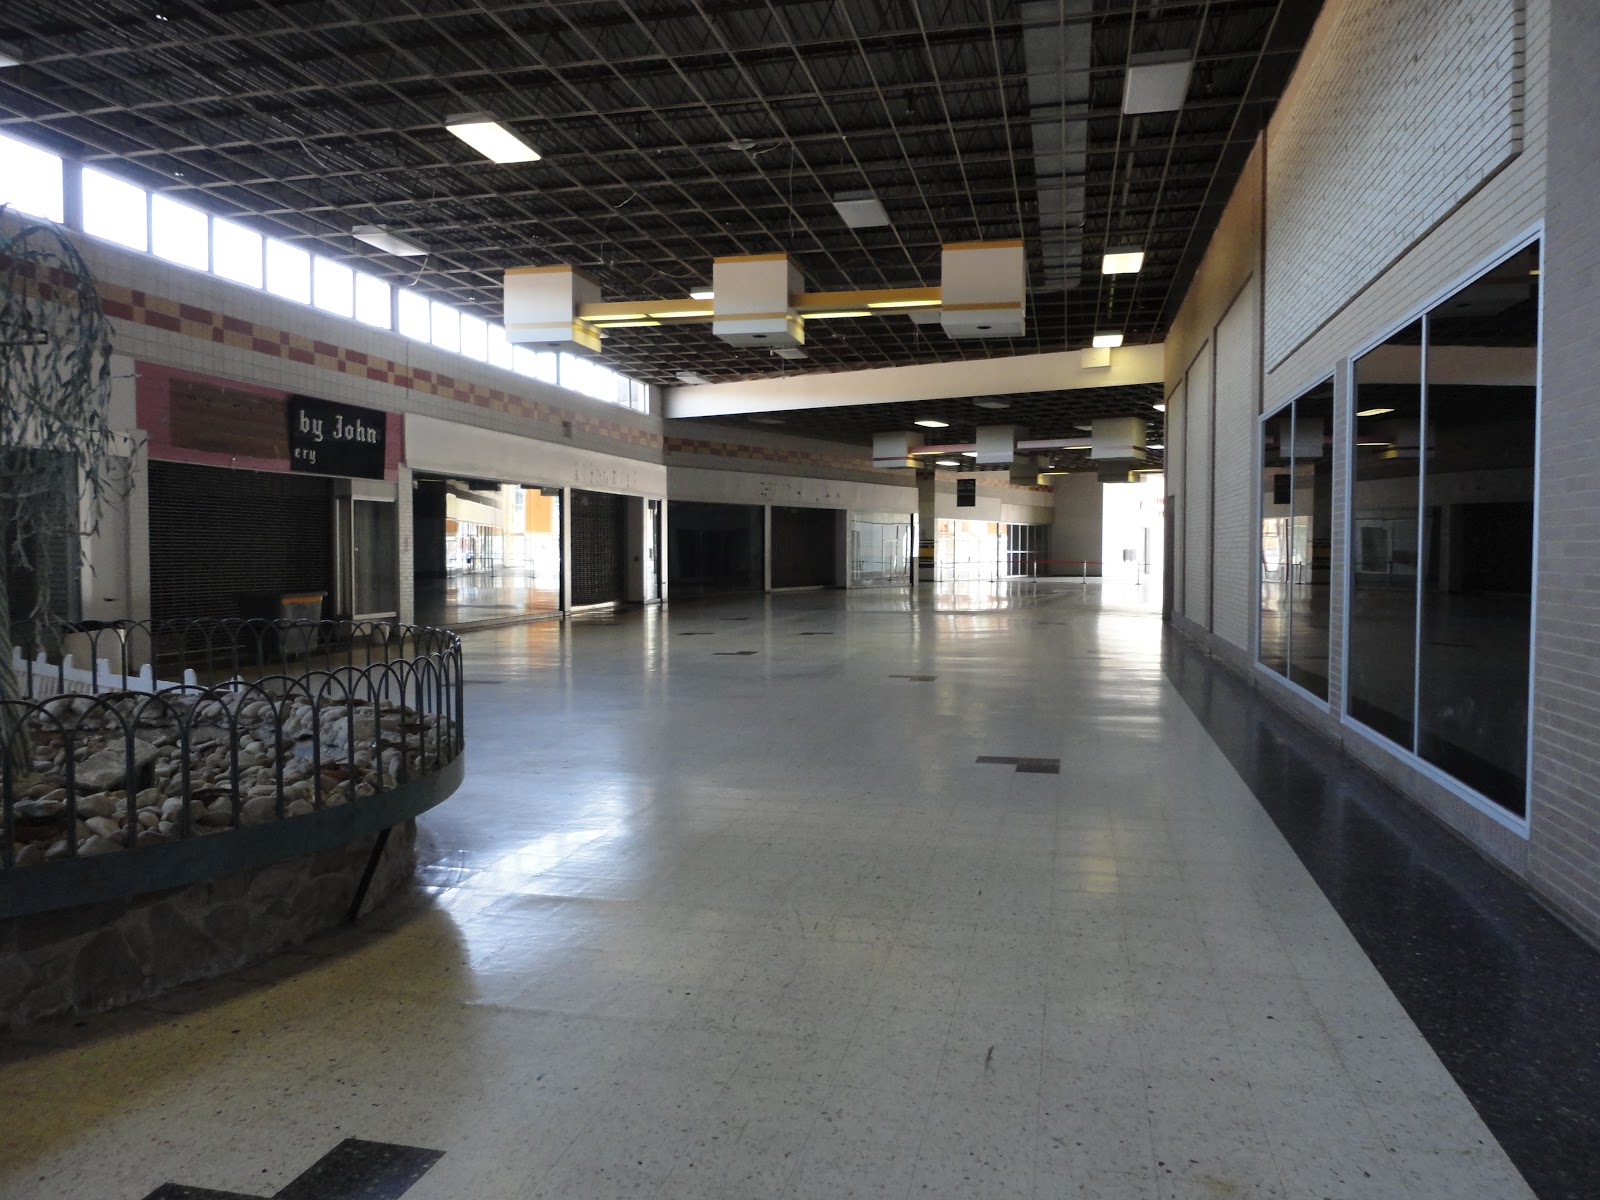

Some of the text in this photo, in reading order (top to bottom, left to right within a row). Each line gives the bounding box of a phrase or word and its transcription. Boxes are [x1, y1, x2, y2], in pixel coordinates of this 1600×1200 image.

[299, 409, 377, 444] by John
[294, 447, 316, 464] ery
